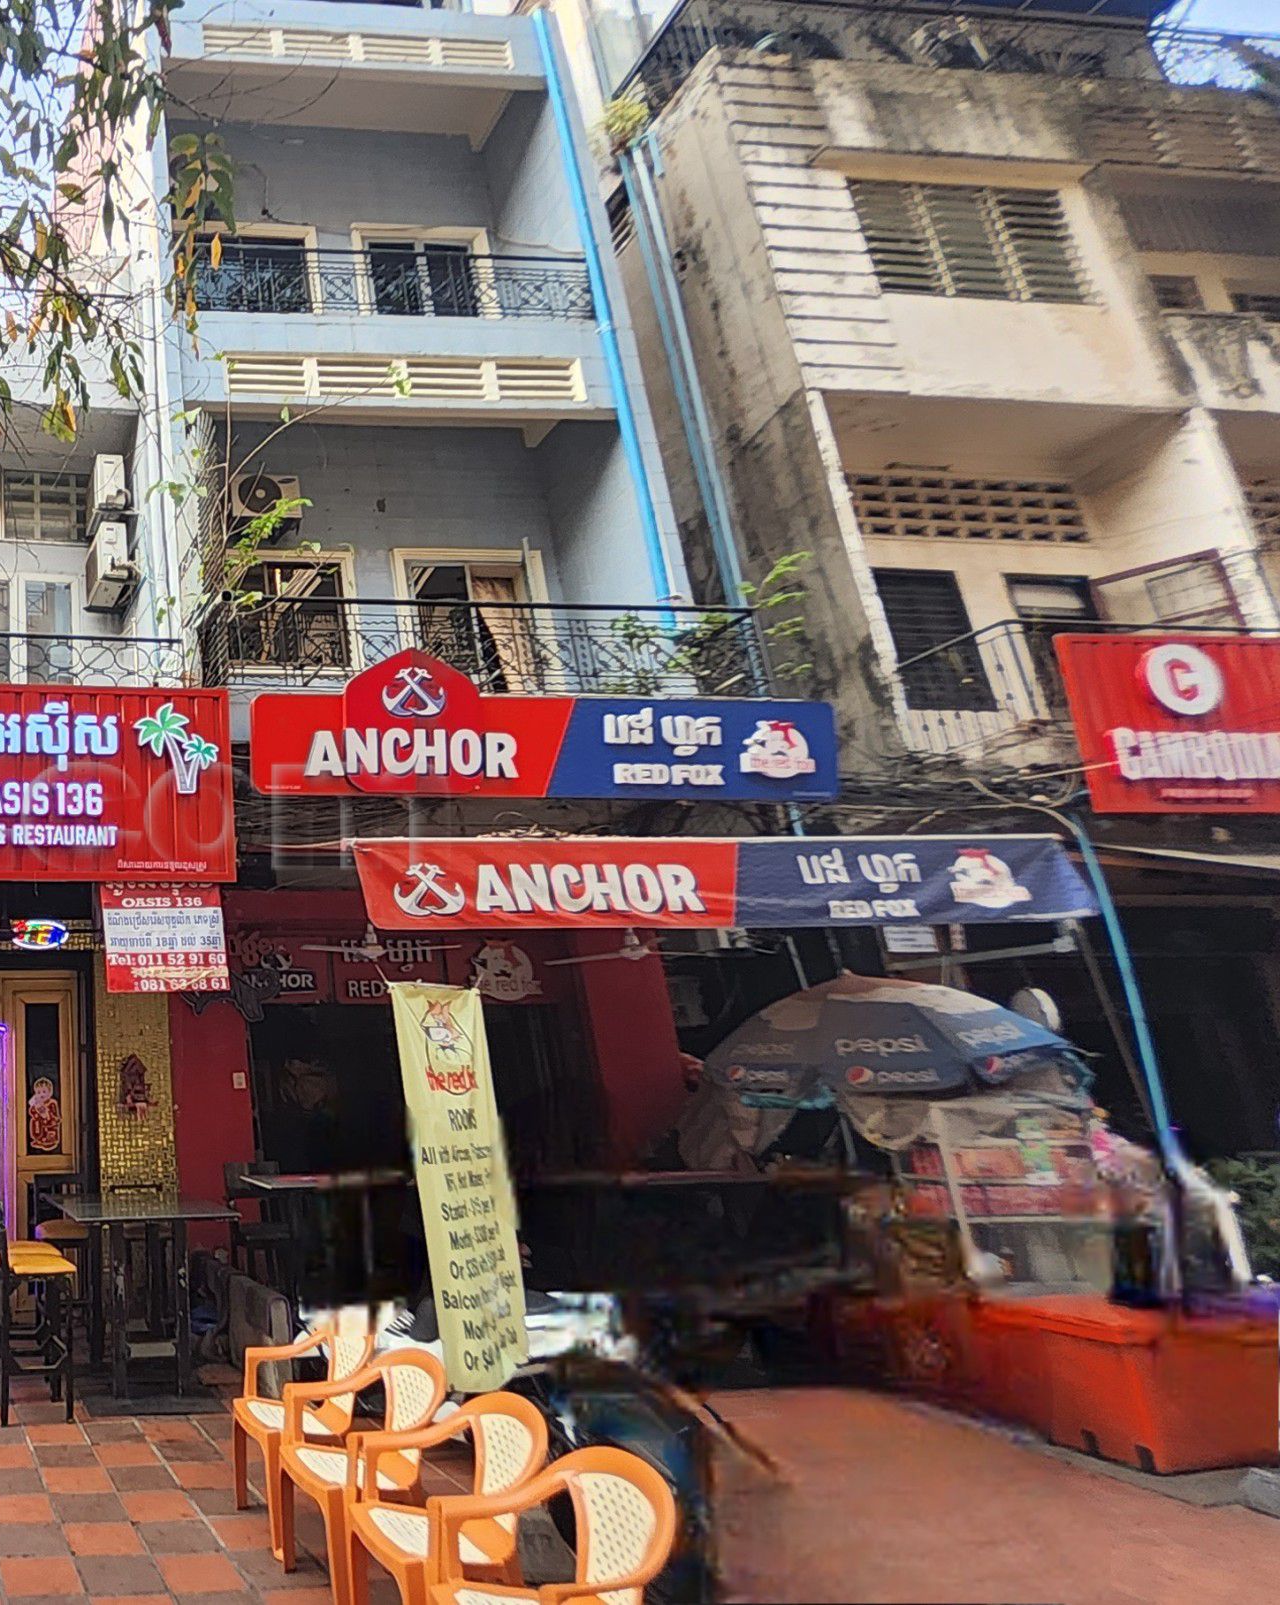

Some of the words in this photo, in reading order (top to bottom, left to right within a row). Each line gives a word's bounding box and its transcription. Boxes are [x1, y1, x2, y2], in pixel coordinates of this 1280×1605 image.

[304, 727, 519, 779] ANCHOR
[613, 763, 670, 785] RED
[671, 764, 727, 786] FOX
[56, 781, 104, 817] 136
[12, 825, 119, 847] RESTAURANT
[476, 863, 706, 914] ANCHOR
[121, 897, 172, 907] OASIS
[176, 896, 202, 907] 136
[167, 953, 185, 966] 52
[189, 953, 205, 965] 91
[209, 953, 226, 965] 60
[211, 978, 228, 990] 61
[347, 979, 383, 998] RED
[835, 1034, 932, 1058] pepsi
[876, 1067, 941, 1084] pepsi
[421, 1145, 437, 1165] All
[449, 1260, 466, 1280] Or
[463, 1350, 480, 1371] Or
